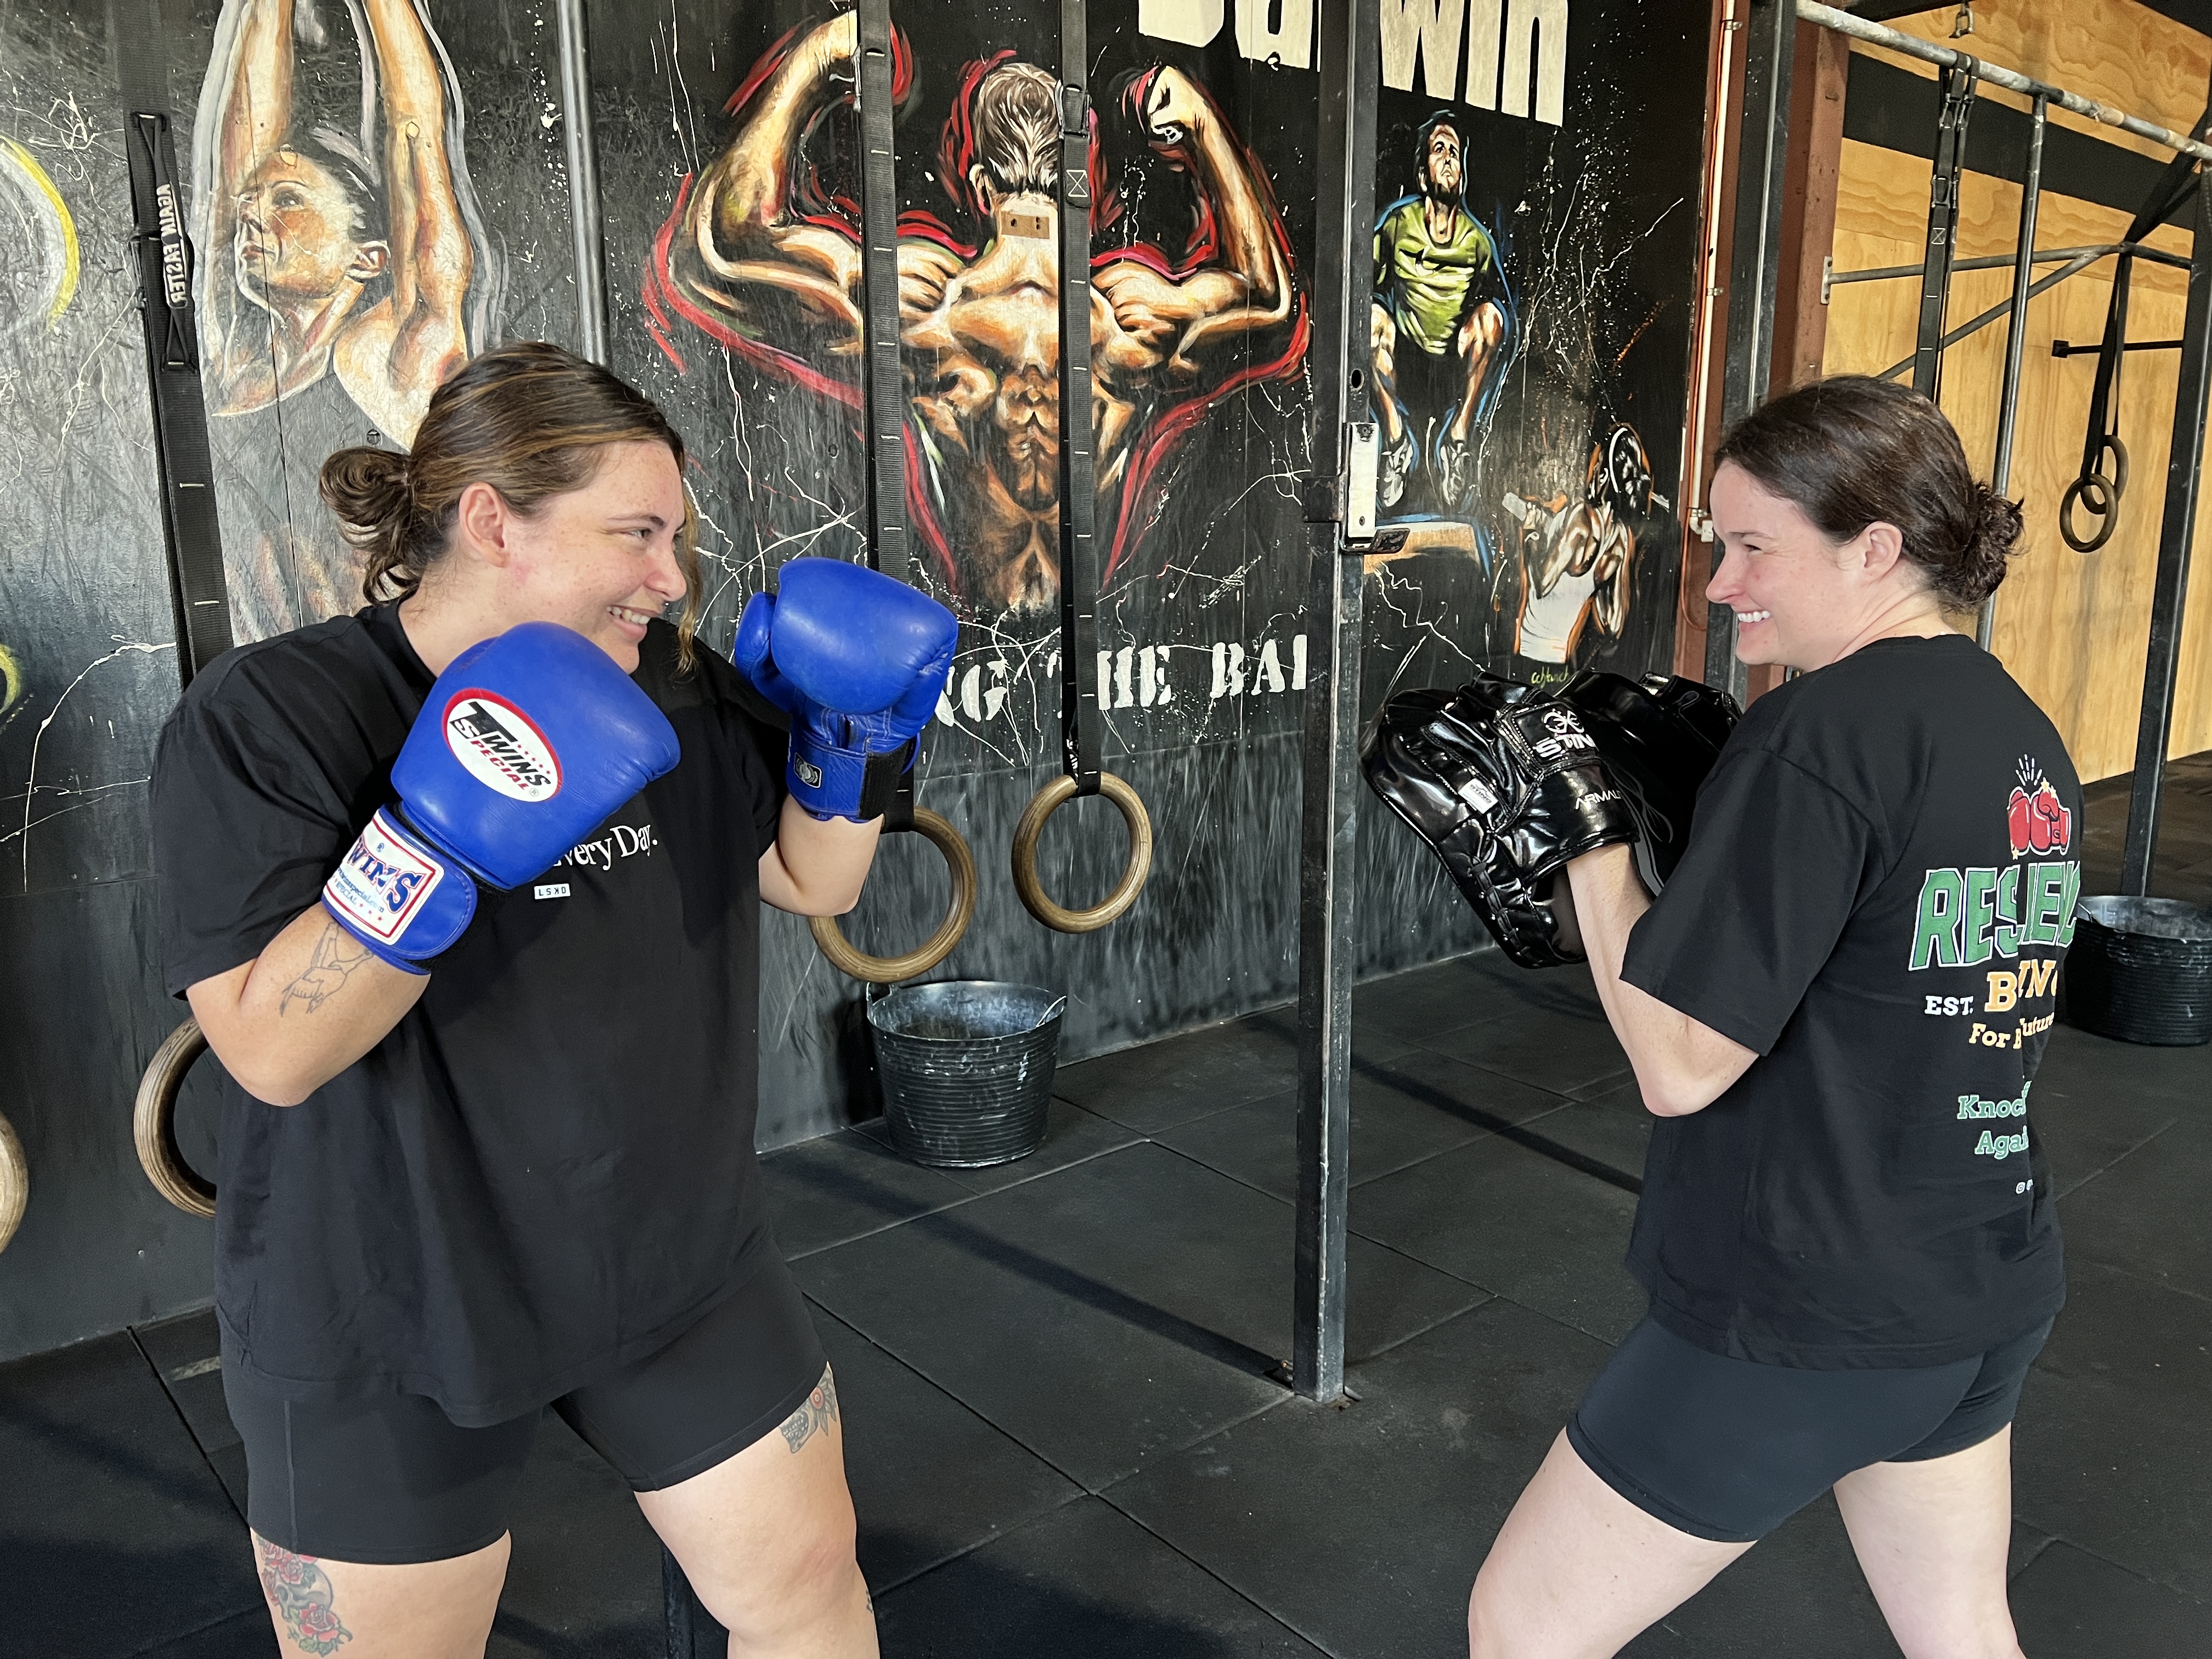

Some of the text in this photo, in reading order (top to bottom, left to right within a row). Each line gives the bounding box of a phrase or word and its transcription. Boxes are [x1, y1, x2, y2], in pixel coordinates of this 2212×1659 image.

[449, 701, 551, 786] TWINS
[1536, 733, 1600, 761] STIN
[553, 825, 658, 871] very Day.
[1925, 995, 1974, 1015] EST.
[1969, 1023, 2011, 1048] For
